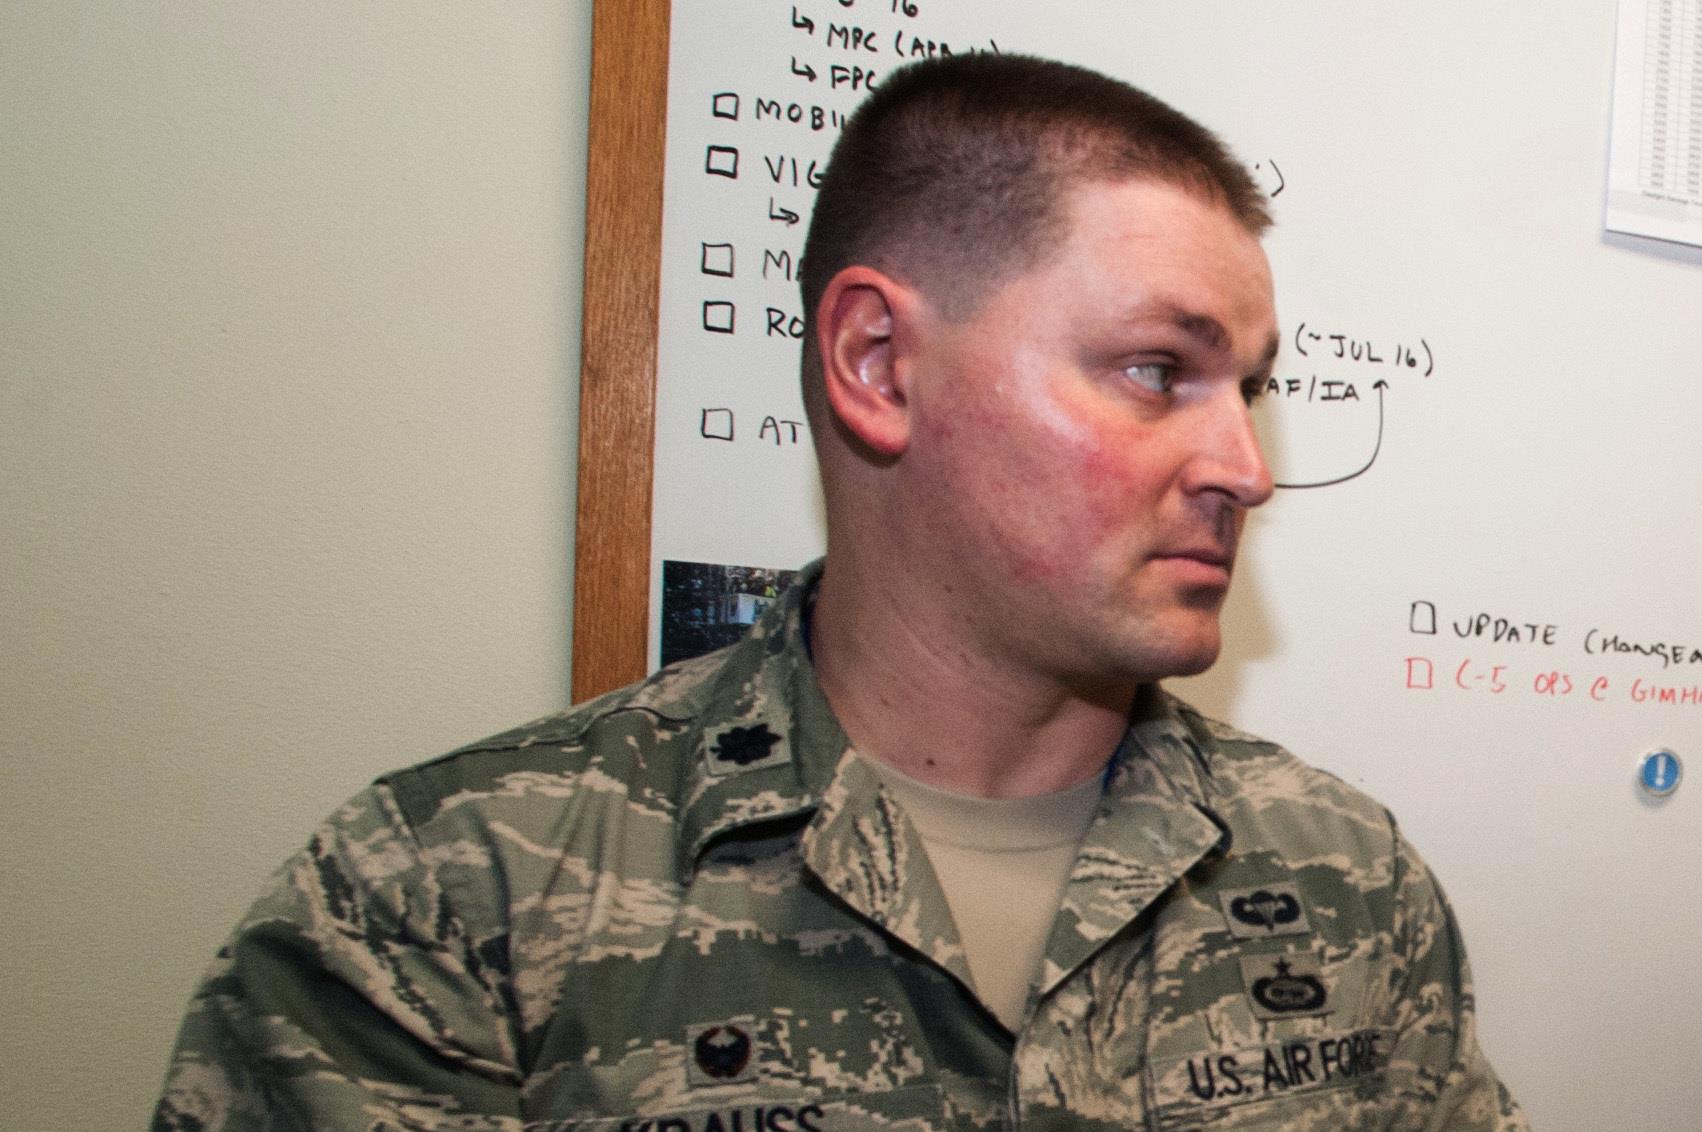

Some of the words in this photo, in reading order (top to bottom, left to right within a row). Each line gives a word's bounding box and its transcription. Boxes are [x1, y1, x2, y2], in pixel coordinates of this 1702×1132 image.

[827, 22, 878, 54] MPC
[831, 64, 879, 92] FPC
[759, 415, 805, 446] AT
[1453, 612, 1558, 647] UPDATE
[1533, 676, 1573, 696] OPS
[1186, 1056, 1254, 1102] U.S.
[1261, 1042, 1315, 1094] AIR
